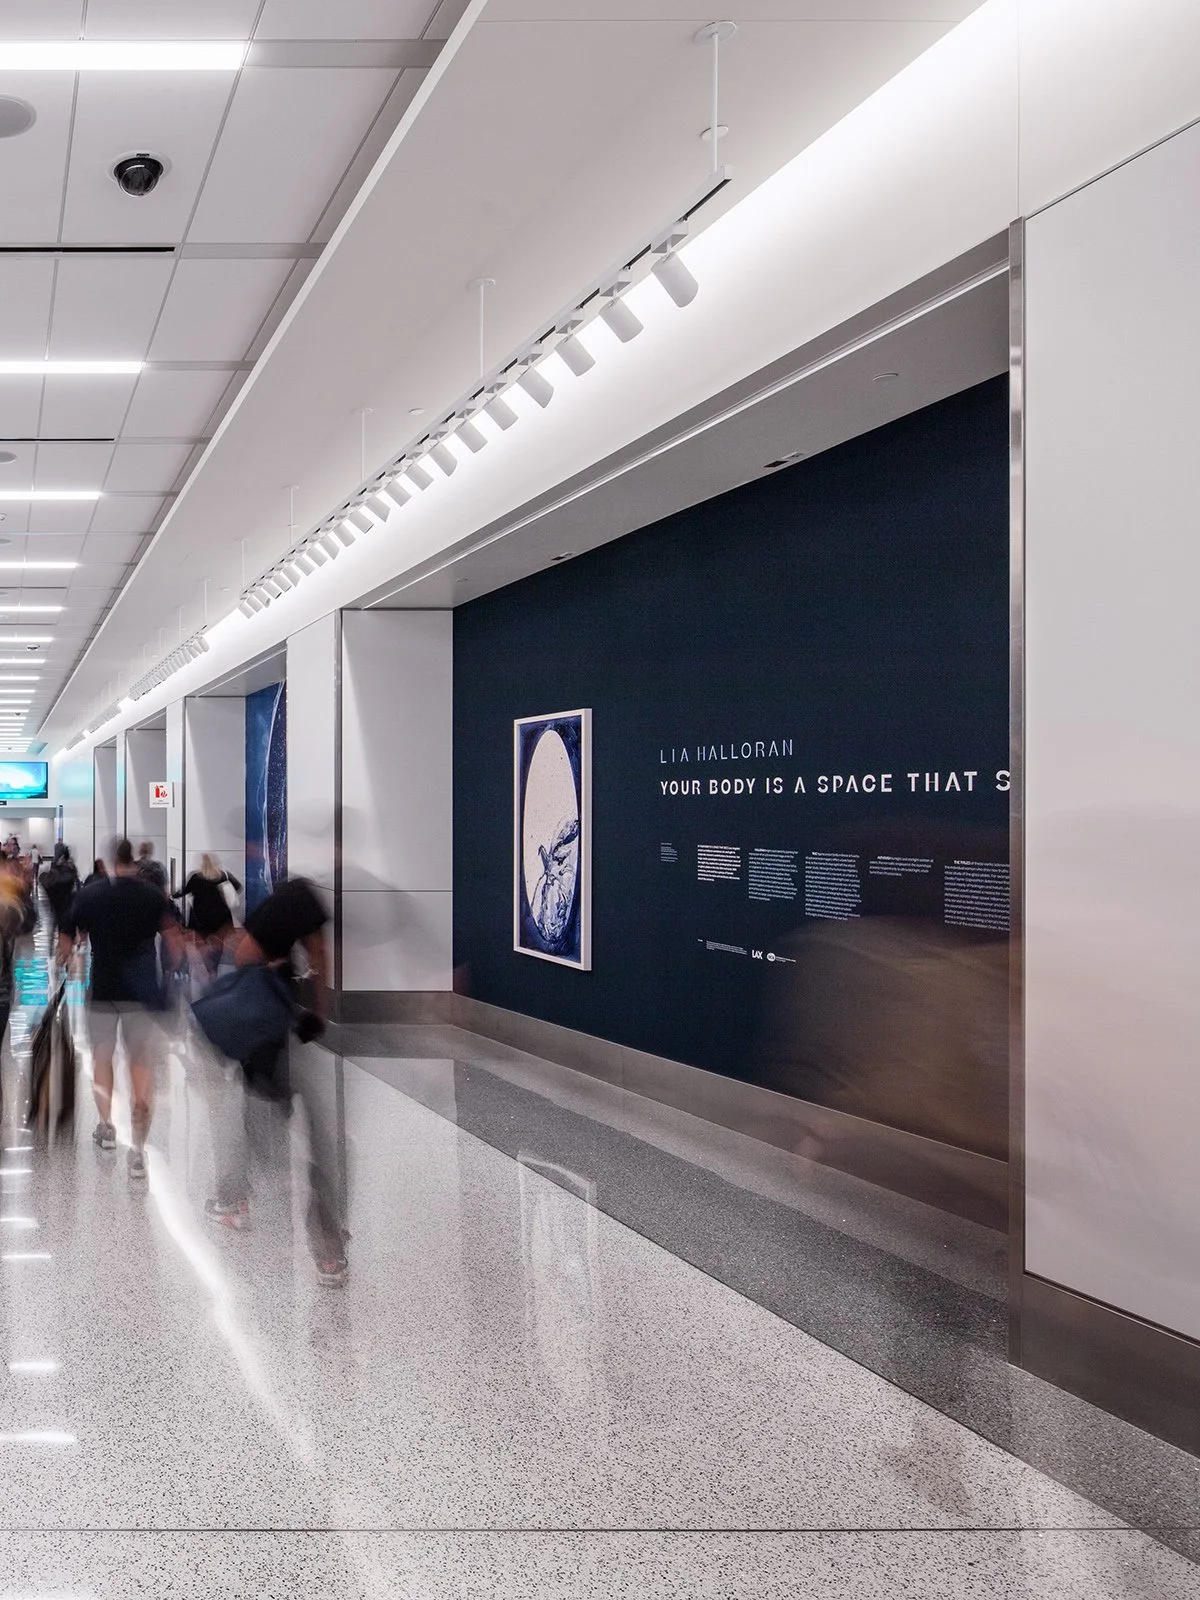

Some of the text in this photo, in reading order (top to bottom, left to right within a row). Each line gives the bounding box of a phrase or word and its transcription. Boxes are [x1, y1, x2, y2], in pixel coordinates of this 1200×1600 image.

[660, 739, 793, 764] LIA HALLORAN
[660, 780, 701, 796] YOUR
[709, 777, 756, 795] BODY
[765, 776, 784, 794] IS
[794, 776, 806, 794] A
[817, 773, 893, 794] SPACE
[906, 771, 978, 793] THAT
[751, 949, 764, 960] LAX
